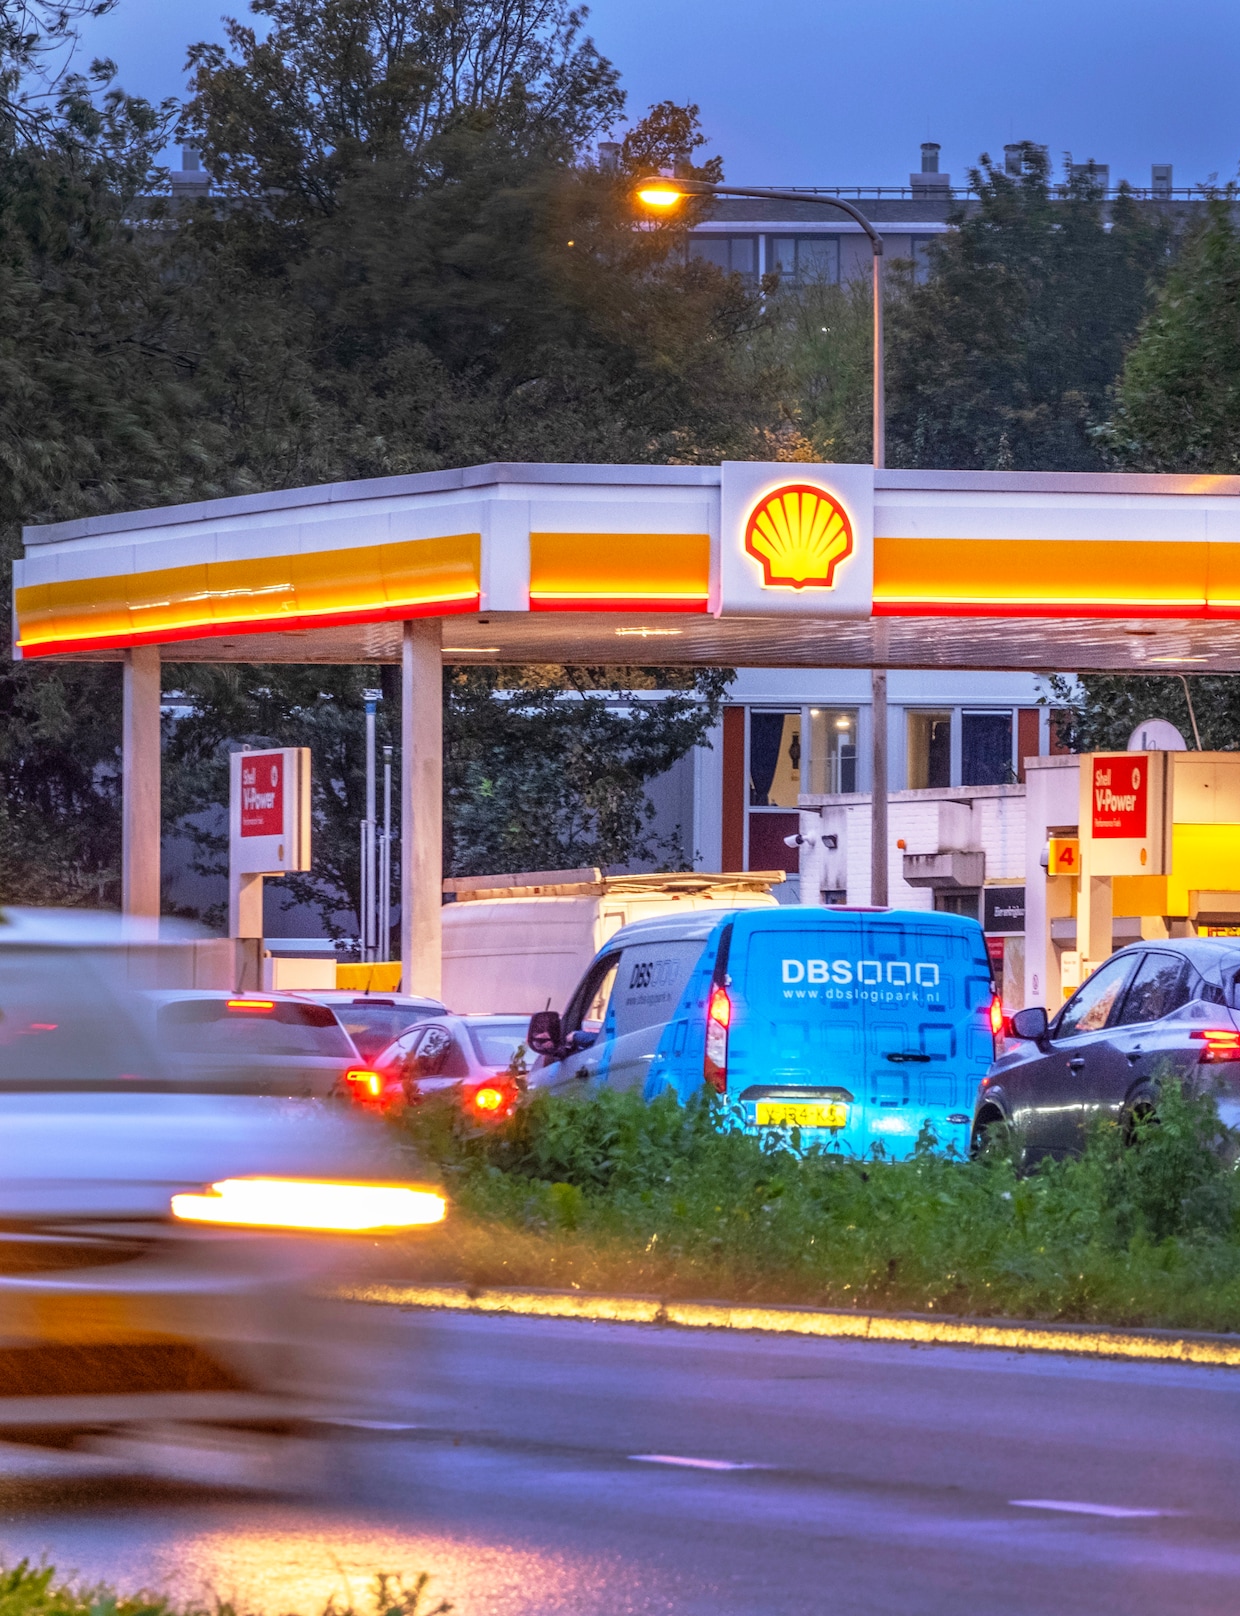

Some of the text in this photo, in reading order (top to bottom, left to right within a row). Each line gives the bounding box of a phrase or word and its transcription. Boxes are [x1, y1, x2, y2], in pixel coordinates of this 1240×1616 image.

[1095, 768, 1112, 787] Shell
[1095, 788, 1137, 812] V-Power
[1059, 847, 1074, 866] 4
[630, 962, 653, 989] DBS
[782, 959, 853, 984] DBS
[783, 988, 940, 1003] www.dbslogipark.nl
